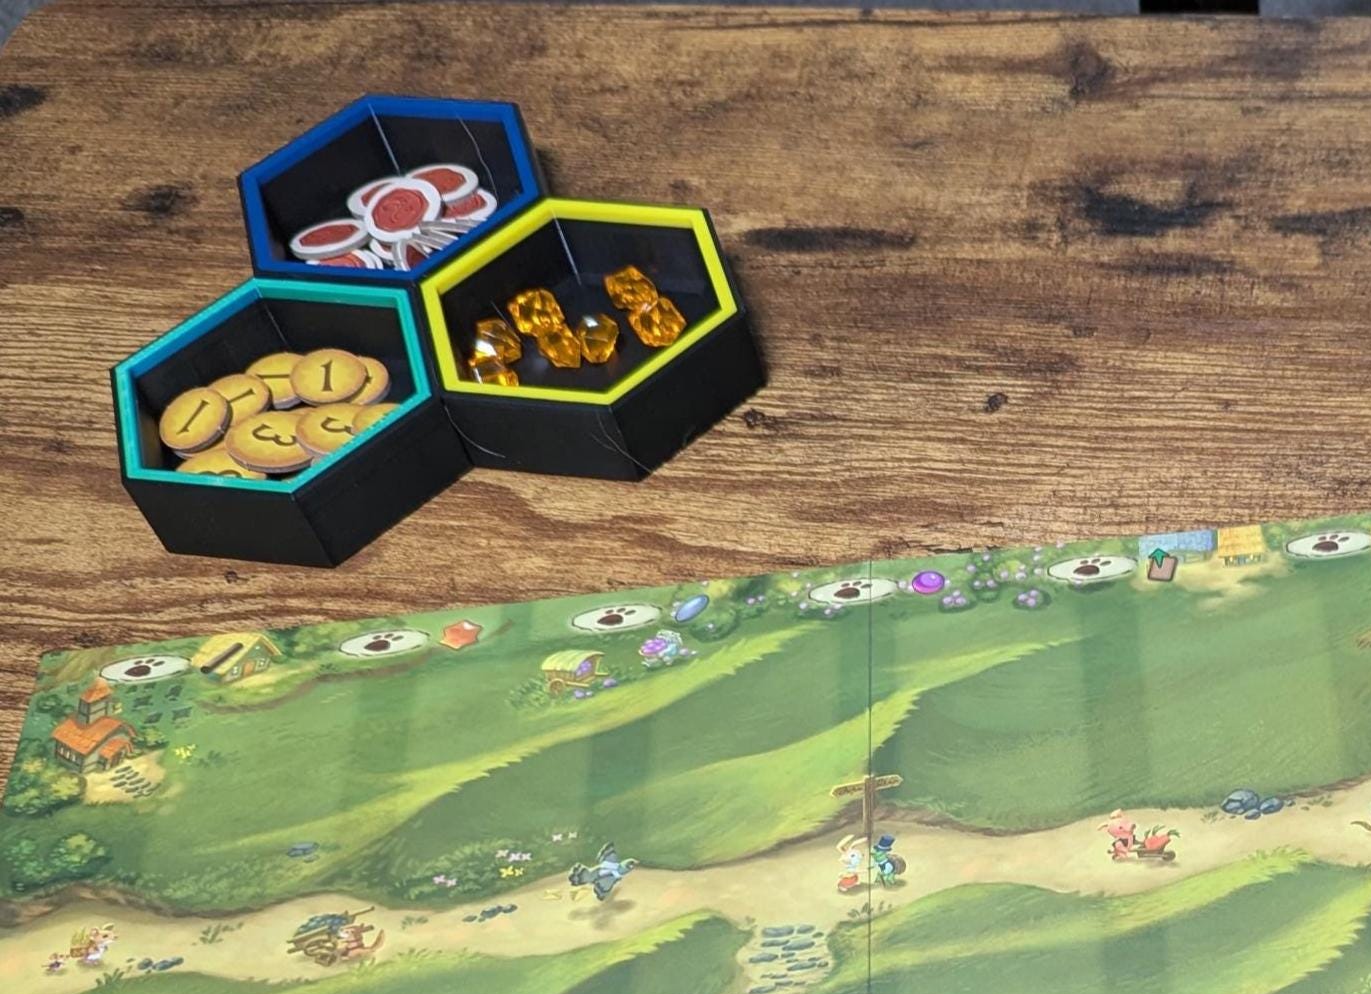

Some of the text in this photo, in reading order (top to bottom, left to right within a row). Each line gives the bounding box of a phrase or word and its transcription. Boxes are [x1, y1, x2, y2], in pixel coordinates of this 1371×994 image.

[320, 360, 333, 392] 1
[176, 399, 210, 436] 1
[252, 423, 297, 446] 3
